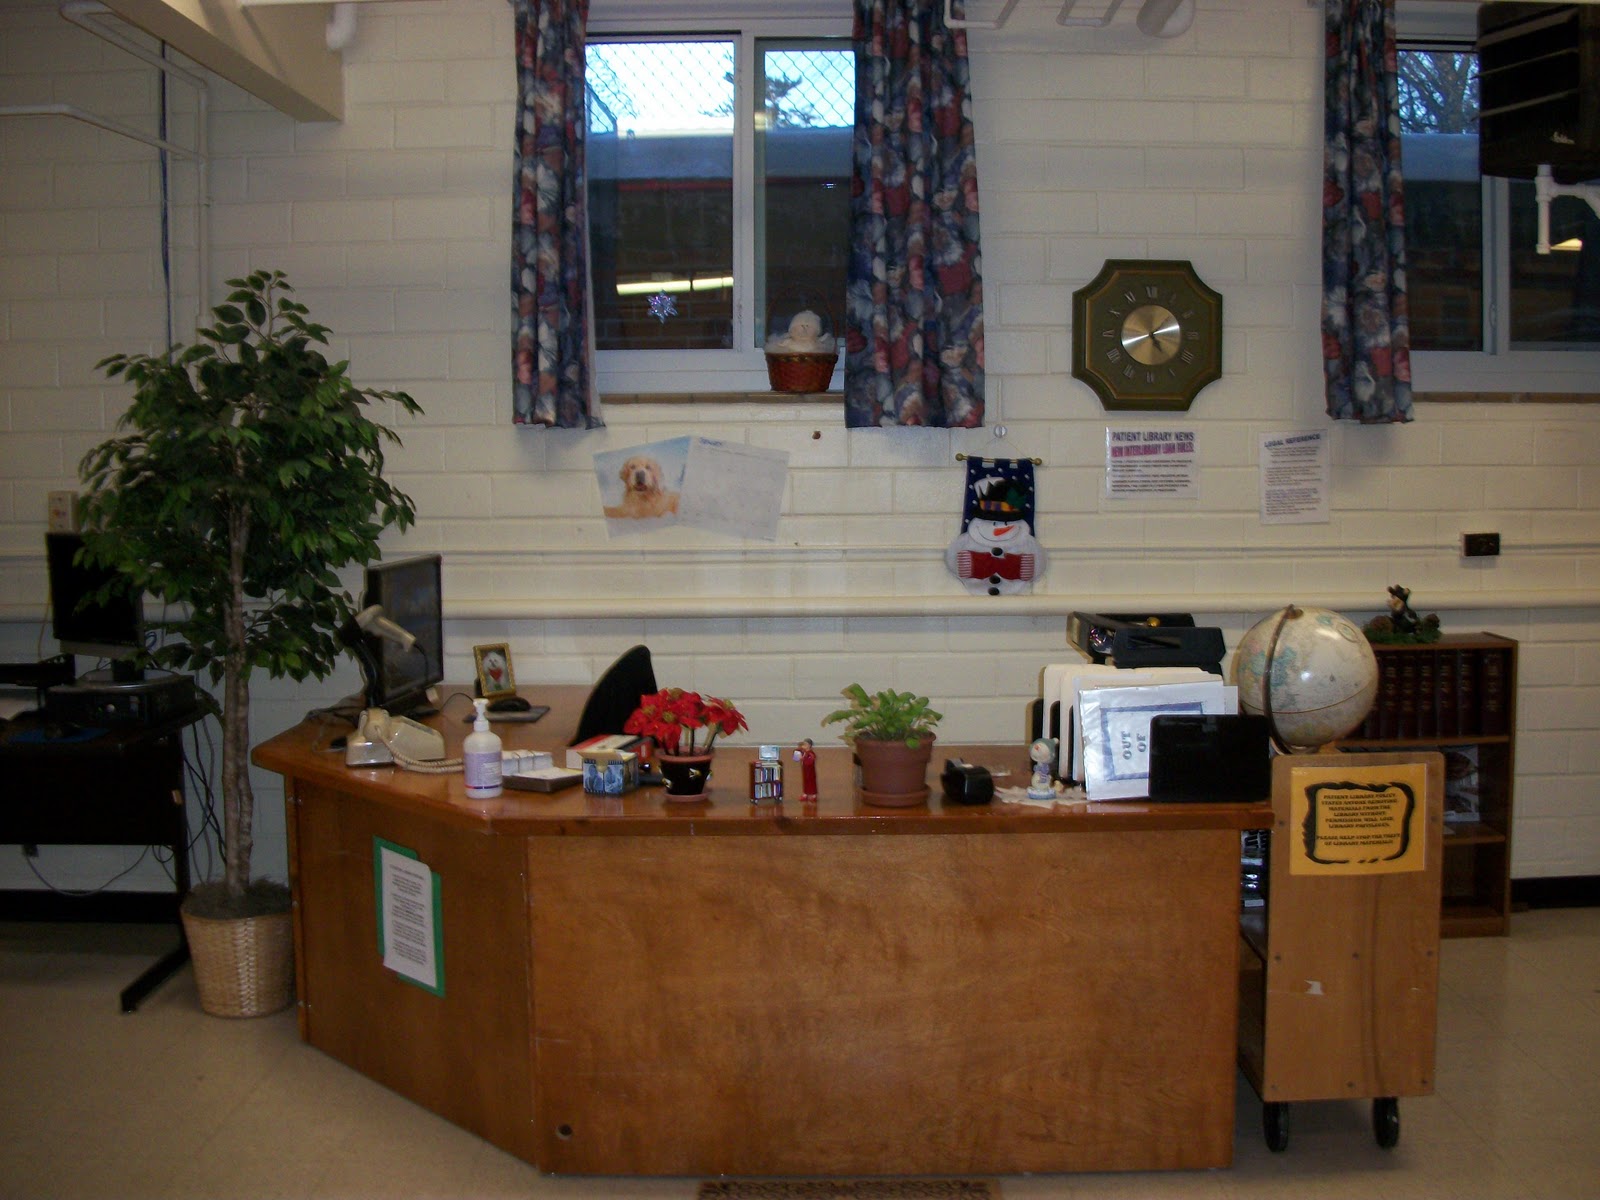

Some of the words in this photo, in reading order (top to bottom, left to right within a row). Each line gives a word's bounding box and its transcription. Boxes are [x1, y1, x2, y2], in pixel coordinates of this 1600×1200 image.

[1112, 431, 1141, 442] PATIENT
[1142, 431, 1173, 442] LIBRARY
[1174, 431, 1195, 441] NEWS
[1285, 433, 1321, 444] REFERENCE
[1121, 730, 1132, 761] OUT
[1136, 733, 1147, 753] OF
